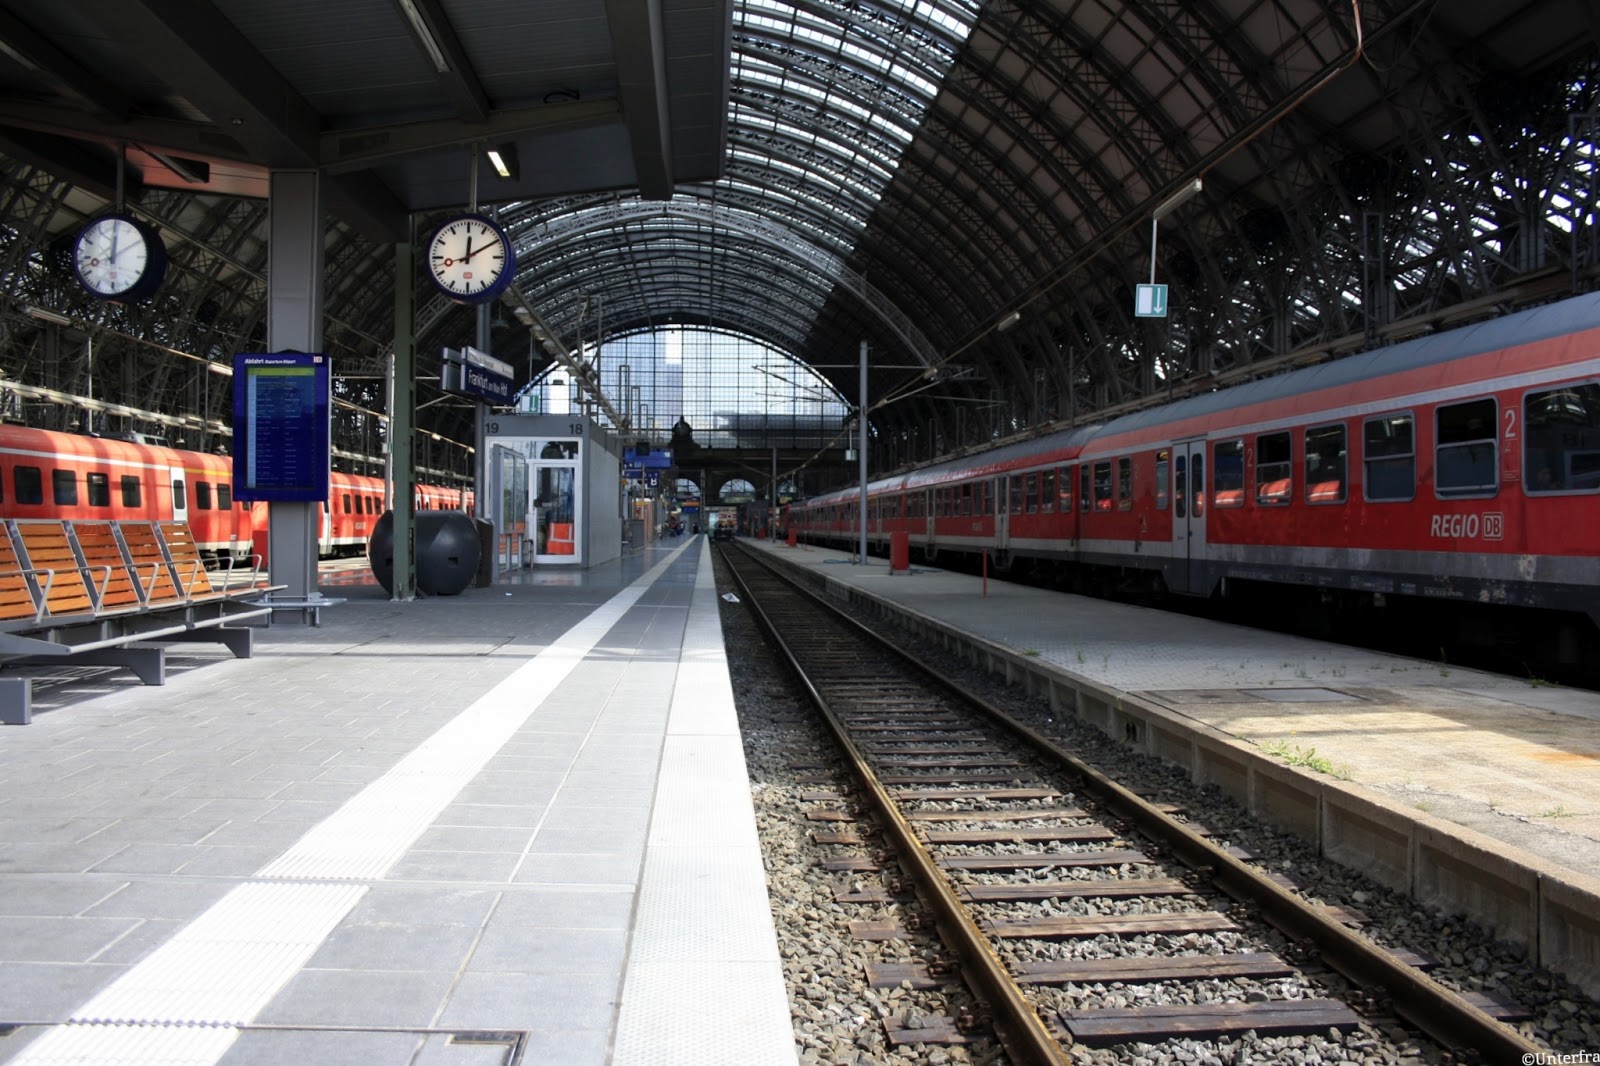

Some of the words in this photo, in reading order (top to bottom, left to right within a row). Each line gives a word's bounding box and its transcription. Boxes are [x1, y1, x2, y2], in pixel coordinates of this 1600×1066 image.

[468, 369, 488, 390] Frankfurt
[500, 381, 508, 397] Hbf
[485, 422, 499, 434] 19
[569, 423, 583, 435] 18
[1504, 408, 1516, 439] 2
[1247, 447, 1253, 468] 2
[1431, 514, 1479, 538] REGIO
[1483, 514, 1503, 538] DB
